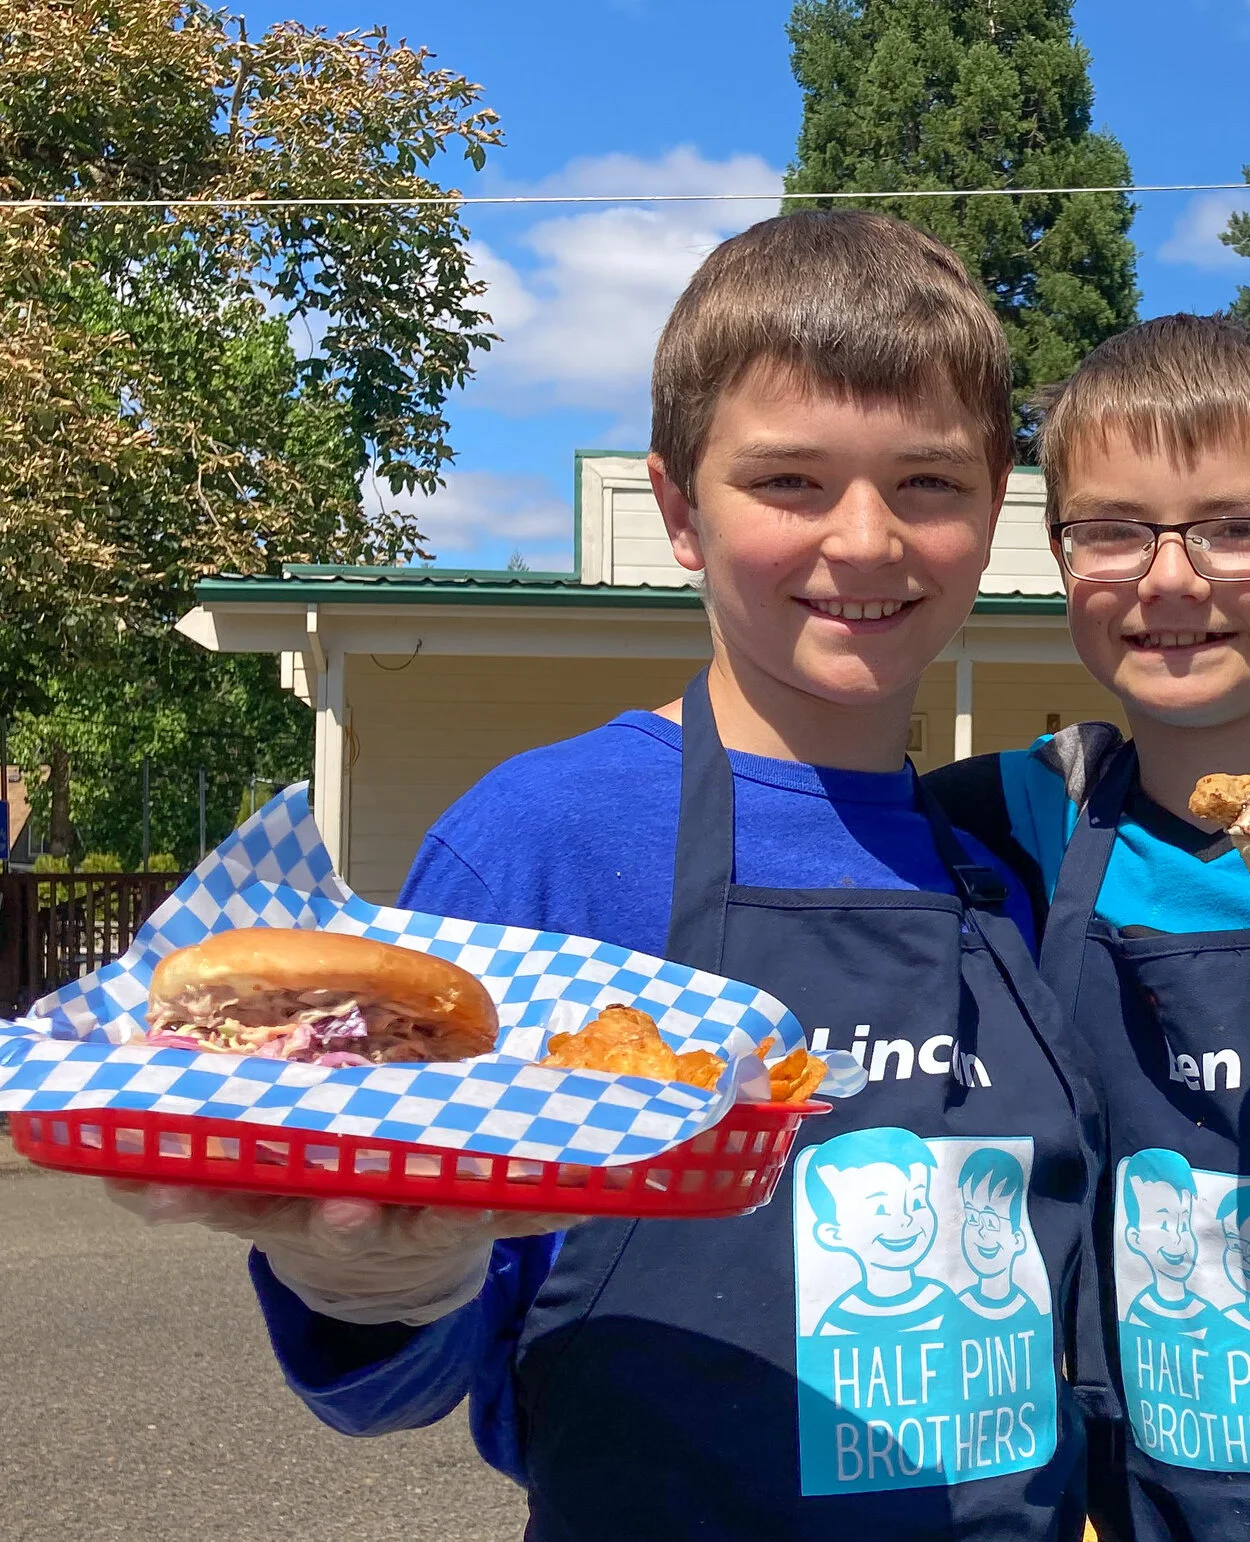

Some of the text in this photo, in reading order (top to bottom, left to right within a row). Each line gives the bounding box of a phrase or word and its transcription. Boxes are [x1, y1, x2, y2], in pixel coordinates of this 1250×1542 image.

[833, 1330, 1035, 1410] HALF PINT
[1136, 1336, 1209, 1400] HALF
[836, 1402, 1036, 1482] BROTHERS
